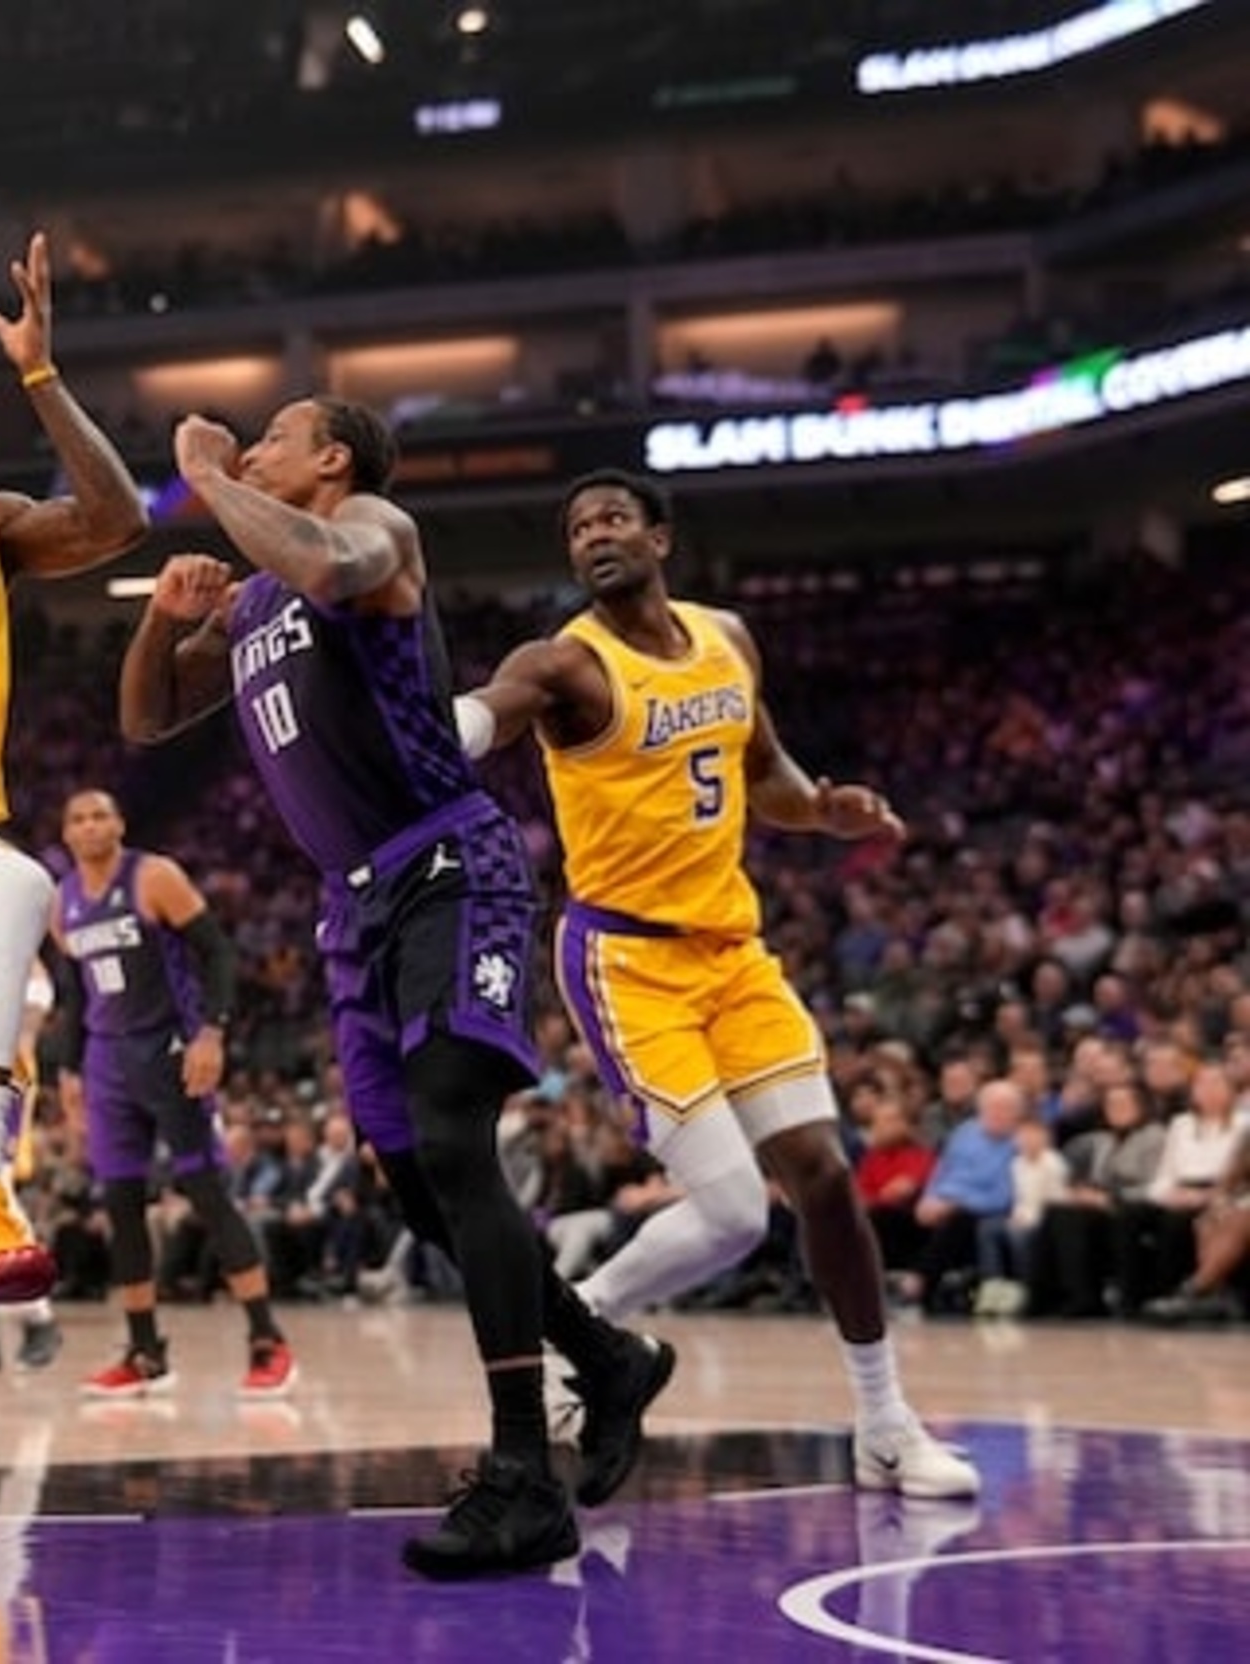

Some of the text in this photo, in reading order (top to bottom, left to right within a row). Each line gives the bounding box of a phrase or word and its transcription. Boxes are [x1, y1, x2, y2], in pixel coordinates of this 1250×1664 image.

[646, 419, 784, 470] SLAM
[792, 404, 934, 460] DUNK
[252, 682, 299, 754] 10
[637, 686, 748, 750] LAKERS
[689, 746, 725, 820] 5
